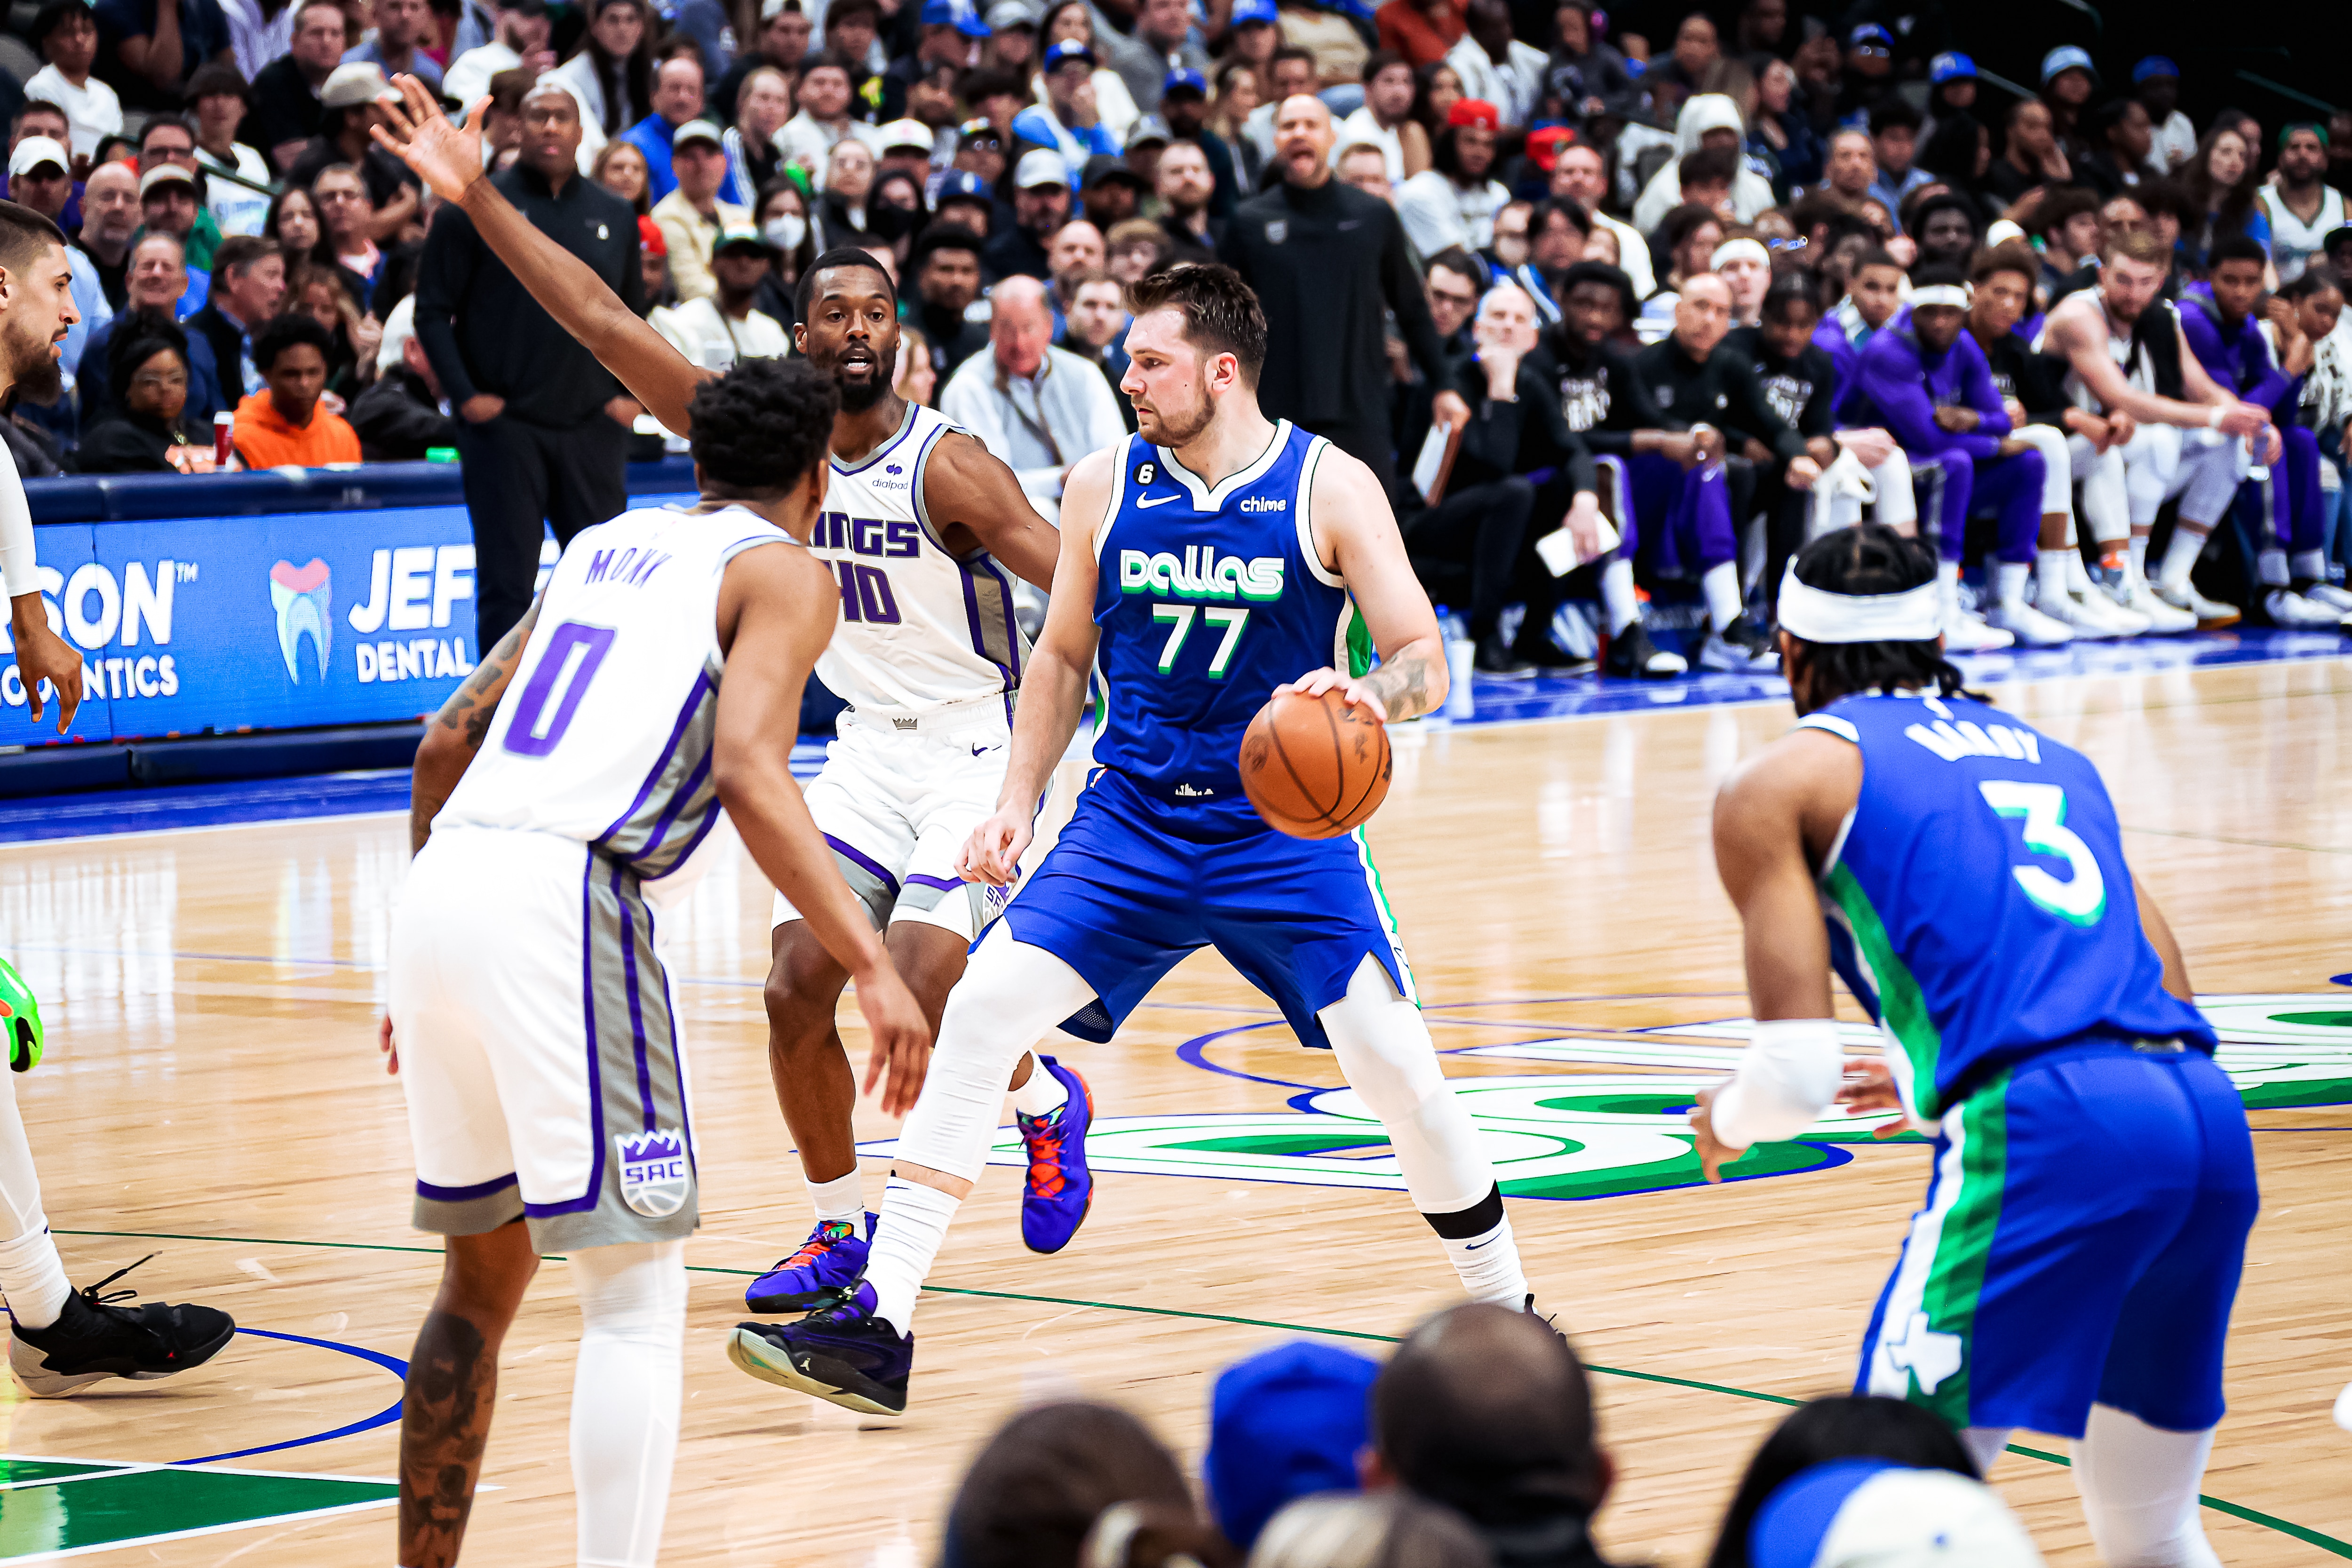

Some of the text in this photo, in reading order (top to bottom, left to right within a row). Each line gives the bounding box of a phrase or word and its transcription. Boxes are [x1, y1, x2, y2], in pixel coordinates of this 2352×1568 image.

[873, 478, 908, 491] dialpad
[1138, 464, 1154, 484] 6
[1240, 495, 1287, 512] chime
[809, 511, 921, 558] INGS
[348, 544, 477, 634] JEF
[356, 637, 476, 683] DENTAL
[1152, 603, 1250, 679] 77
[500, 619, 618, 760] 0
[1979, 780, 2107, 928] 3
[626, 1161, 683, 1185] SAC
